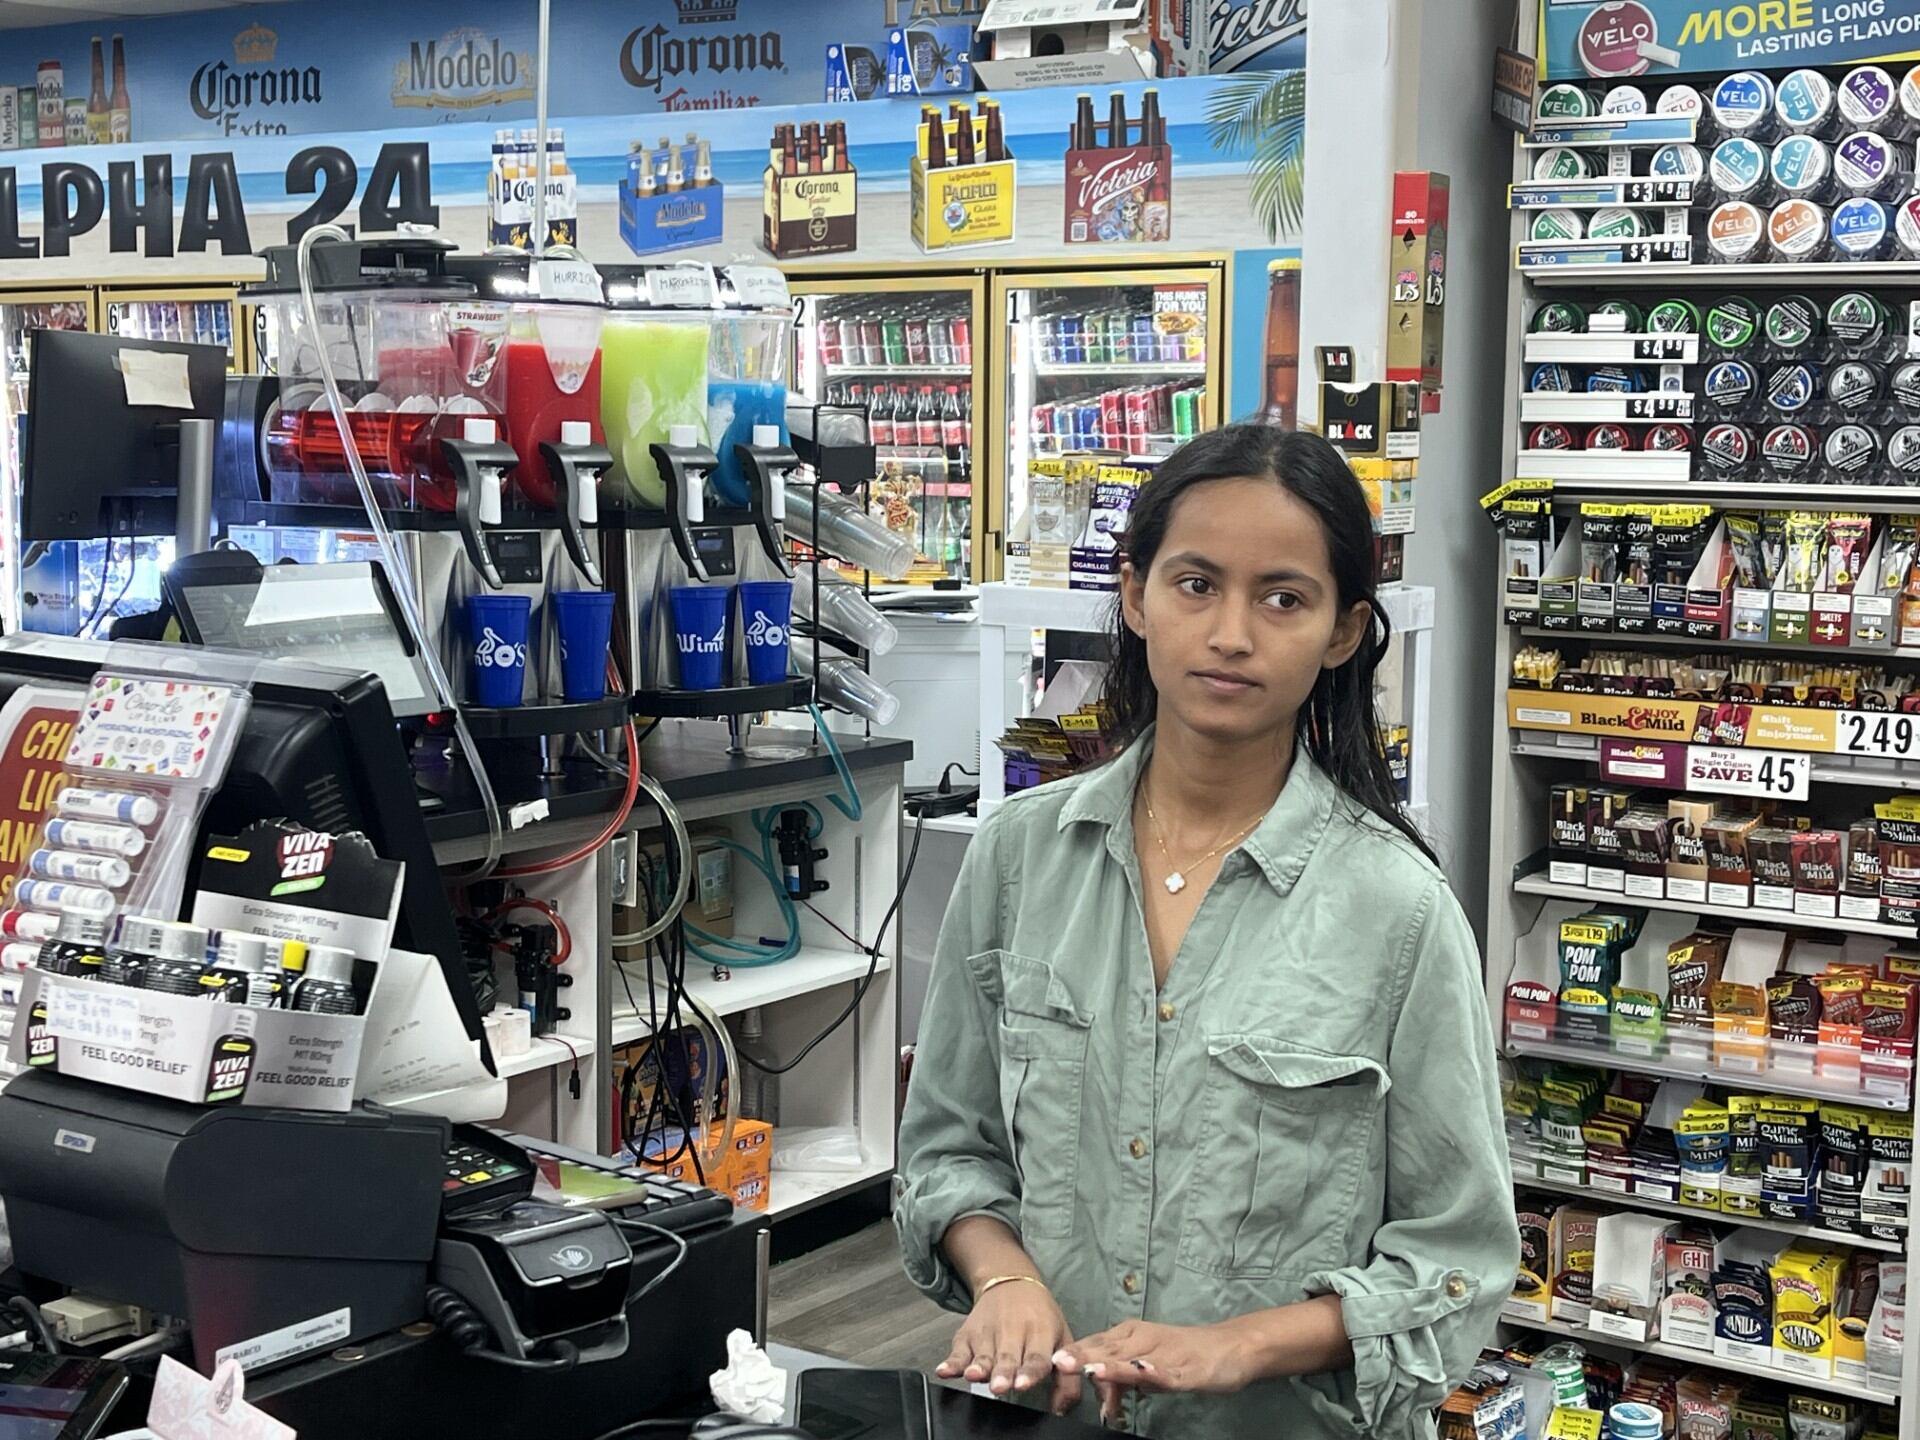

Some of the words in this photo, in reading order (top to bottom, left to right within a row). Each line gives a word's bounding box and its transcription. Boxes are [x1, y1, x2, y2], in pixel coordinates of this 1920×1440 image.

[1677, 0, 1814, 46] MORE
[1822, 0, 1886, 24] LONG
[1587, 22, 1649, 48] VELO
[1737, 30, 1834, 58] LASTING
[409, 38, 517, 90] Modelo
[620, 24, 784, 93] Corona
[190, 60, 322, 125] Corona
[1721, 90, 1760, 104] VELO
[1853, 73, 1885, 110] VELO
[1544, 99, 1581, 114] VELO
[1535, 134, 1561, 142] VELO
[1725, 145, 1755, 176] VELO
[1849, 142, 1883, 172] VELO
[1079, 151, 1159, 208] Victoria
[286, 142, 439, 245] 24
[795, 179, 840, 199] Corona
[1522, 195, 1548, 204] VELO
[1715, 216, 1754, 232] VELO
[1774, 211, 1813, 236] VELO
[1838, 214, 1881, 228] VELO
[1530, 255, 1557, 264] VELO
[793, 297, 805, 328] 2
[1009, 291, 1020, 324] 1
[1156, 301, 1181, 311] FOR
[1182, 300, 1206, 311] YOU
[109, 306, 119, 331] 6
[258, 306, 267, 330] 5
[1583, 521, 1612, 538] game
[1656, 532, 1690, 547] game
[1508, 610, 1533, 623] game
[1544, 616, 1569, 629] game
[1581, 616, 1607, 629] game
[1618, 617, 1645, 631] game
[1656, 618, 1683, 631] game
[1688, 622, 1715, 635] game
[1580, 712, 1628, 728] Black
[1645, 717, 1686, 732] Mild
[1761, 713, 1793, 725] Shift
[1757, 729, 1827, 743] Enjoyment.
[1785, 724, 1815, 734] Your
[1693, 758, 1722, 767] Single
[1723, 760, 1752, 769] Cigars
[1710, 751, 1729, 760] Buy
[1691, 766, 1753, 783] SAVE
[1556, 820, 1586, 831] Black
[1880, 821, 1917, 838] game
[283, 833, 331, 855] VIVA
[1674, 835, 1704, 848] Black
[1679, 846, 1704, 857] Mild
[1712, 853, 1744, 863] Black
[281, 851, 325, 878] ZEN
[1756, 859, 1789, 870] Black
[1763, 867, 1791, 878] Mild
[1800, 862, 1833, 872] Black
[1806, 870, 1835, 880] Mild
[243, 905, 264, 917] Extra
[265, 907, 298, 922] Strength
[1565, 945, 1597, 965] POM
[1569, 964, 1602, 983] POM
[1511, 985, 1530, 999] POM
[1529, 988, 1551, 1002] POM
[1615, 1001, 1634, 1014] POM
[1634, 1004, 1656, 1017] POM
[1673, 994, 1707, 1010] LEAF
[1519, 1009, 1540, 1019] RED
[289, 1035, 311, 1046] Extra
[311, 1037, 343, 1050] Strength
[81, 1045, 109, 1061] FEEL
[110, 1051, 144, 1068] GOOD
[146, 1058, 189, 1075] RELIEF
[214, 1056, 250, 1074] VIVA
[212, 1069, 246, 1090] ZEN
[255, 1071, 283, 1084] FEEL
[284, 1074, 316, 1086] GOOD
[318, 1076, 352, 1088] RELIEF
[1549, 1125, 1576, 1140] MINI
[1761, 1123, 1800, 1141] game
[1773, 1134, 1804, 1145] Minis
[1821, 1124, 1853, 1141] game
[1830, 1137, 1857, 1150] Minis
[1872, 1138, 1911, 1153] game
[1689, 1149, 1723, 1161] MINI
[1724, 1313, 1762, 1335] VANILLA
[1781, 1327, 1821, 1348] BANANA
